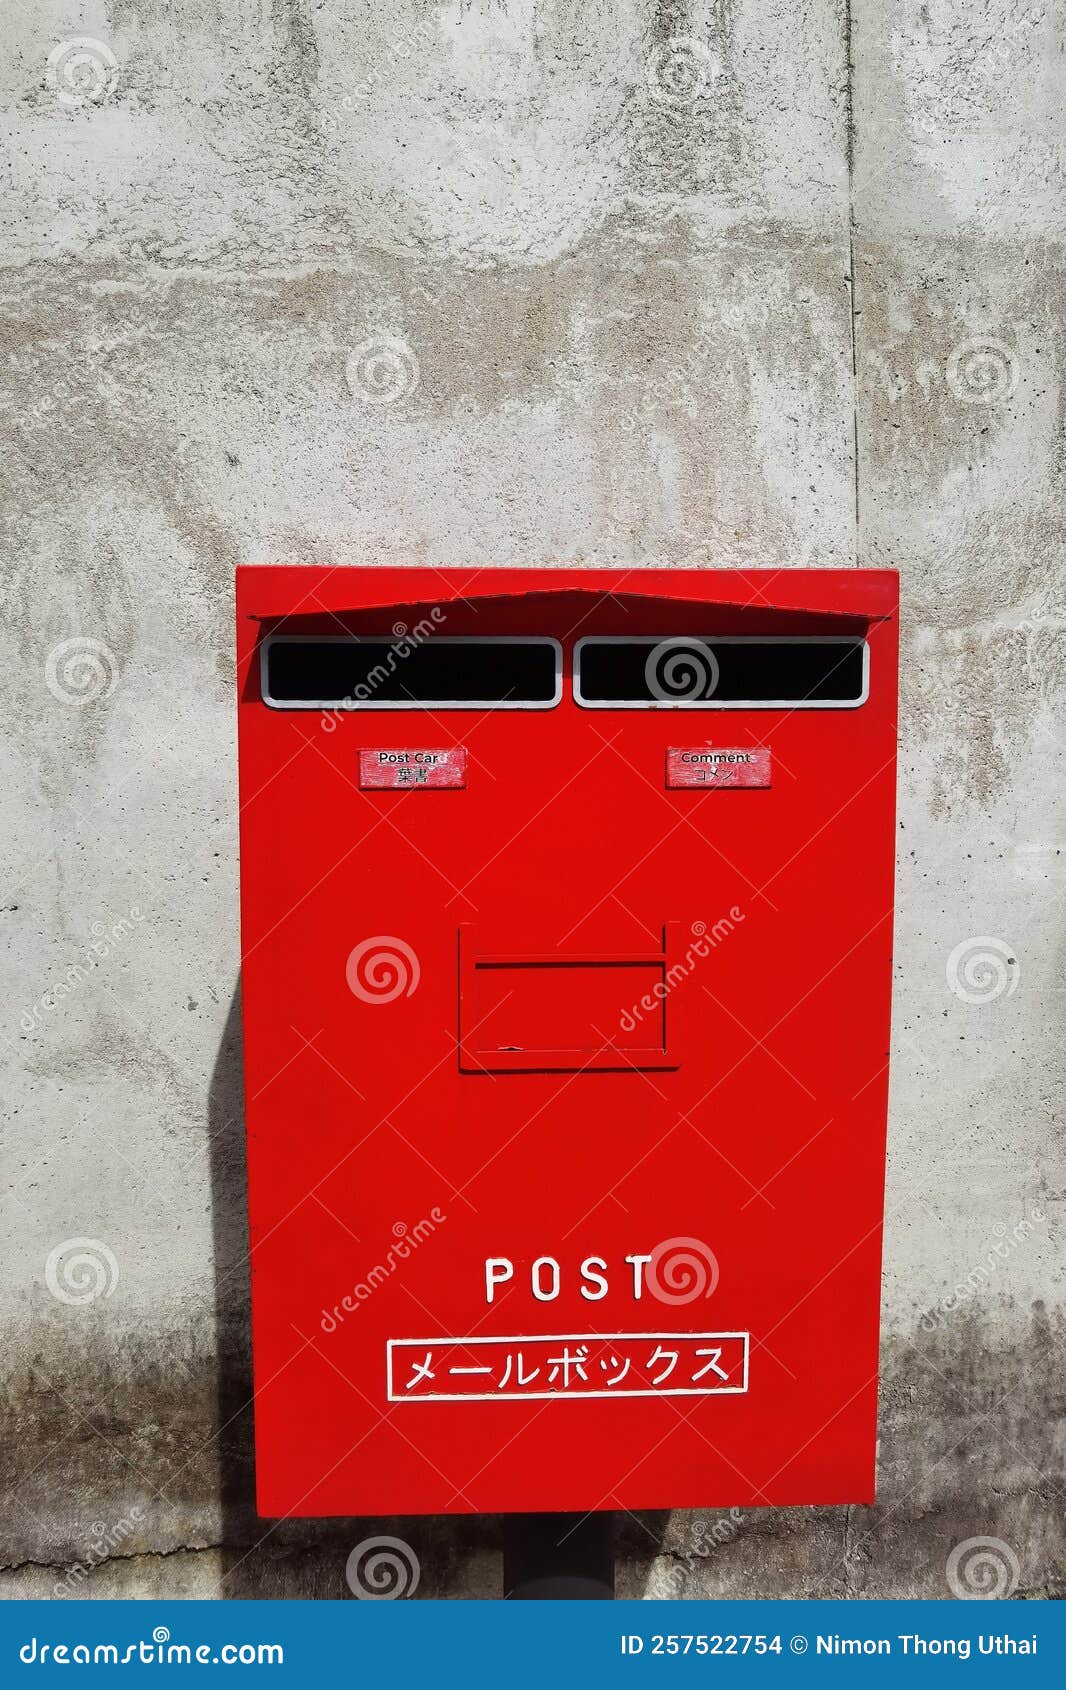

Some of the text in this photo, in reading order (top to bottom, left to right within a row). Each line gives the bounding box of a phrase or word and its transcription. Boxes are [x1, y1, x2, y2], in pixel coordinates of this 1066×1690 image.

[379, 752, 409, 763] Post
[681, 753, 751, 763] Comment
[485, 1255, 653, 1303] POST
[406, 1345, 730, 1390] メールボックス
